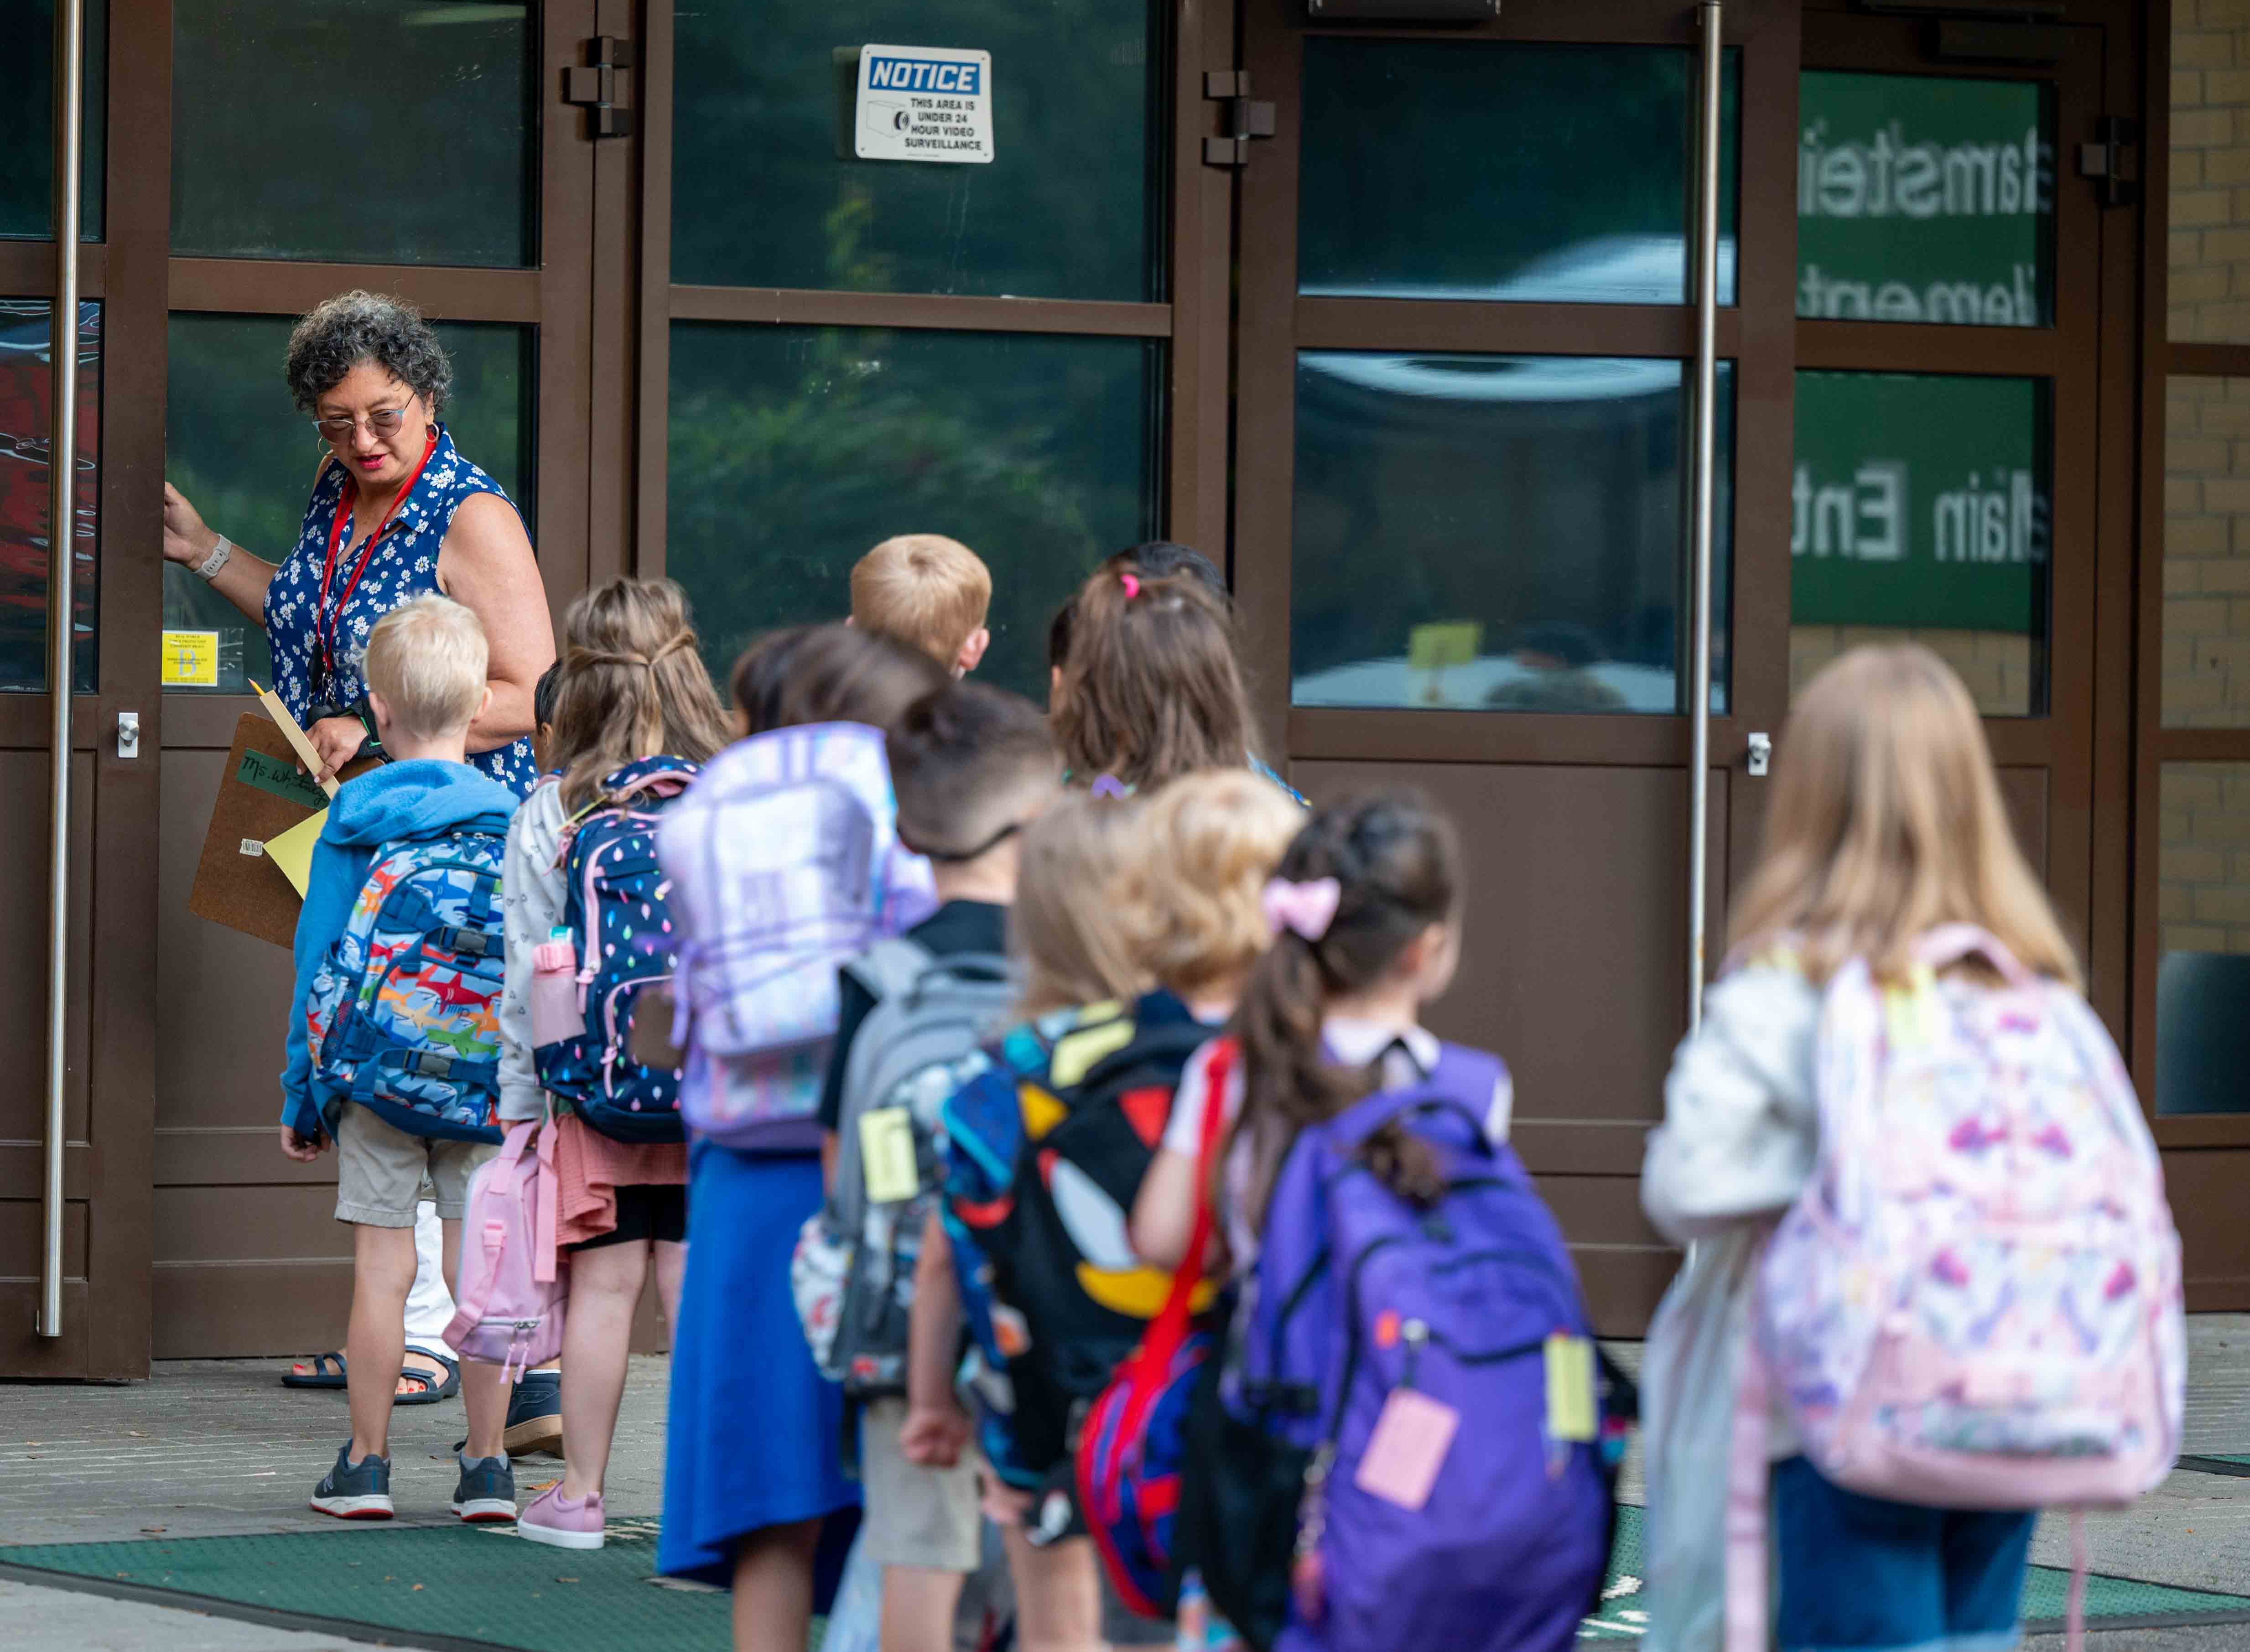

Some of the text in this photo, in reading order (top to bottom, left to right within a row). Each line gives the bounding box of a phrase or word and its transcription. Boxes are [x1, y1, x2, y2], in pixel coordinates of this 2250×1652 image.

[871, 61, 978, 91] NOTICE
[910, 98, 975, 111] THIS AREA IS
[917, 112, 968, 124] UNDER 24
[910, 125, 975, 137] HOUR VIDEO
[904, 138, 982, 151] SURVEILLANCE
[179, 649, 197, 676] B
